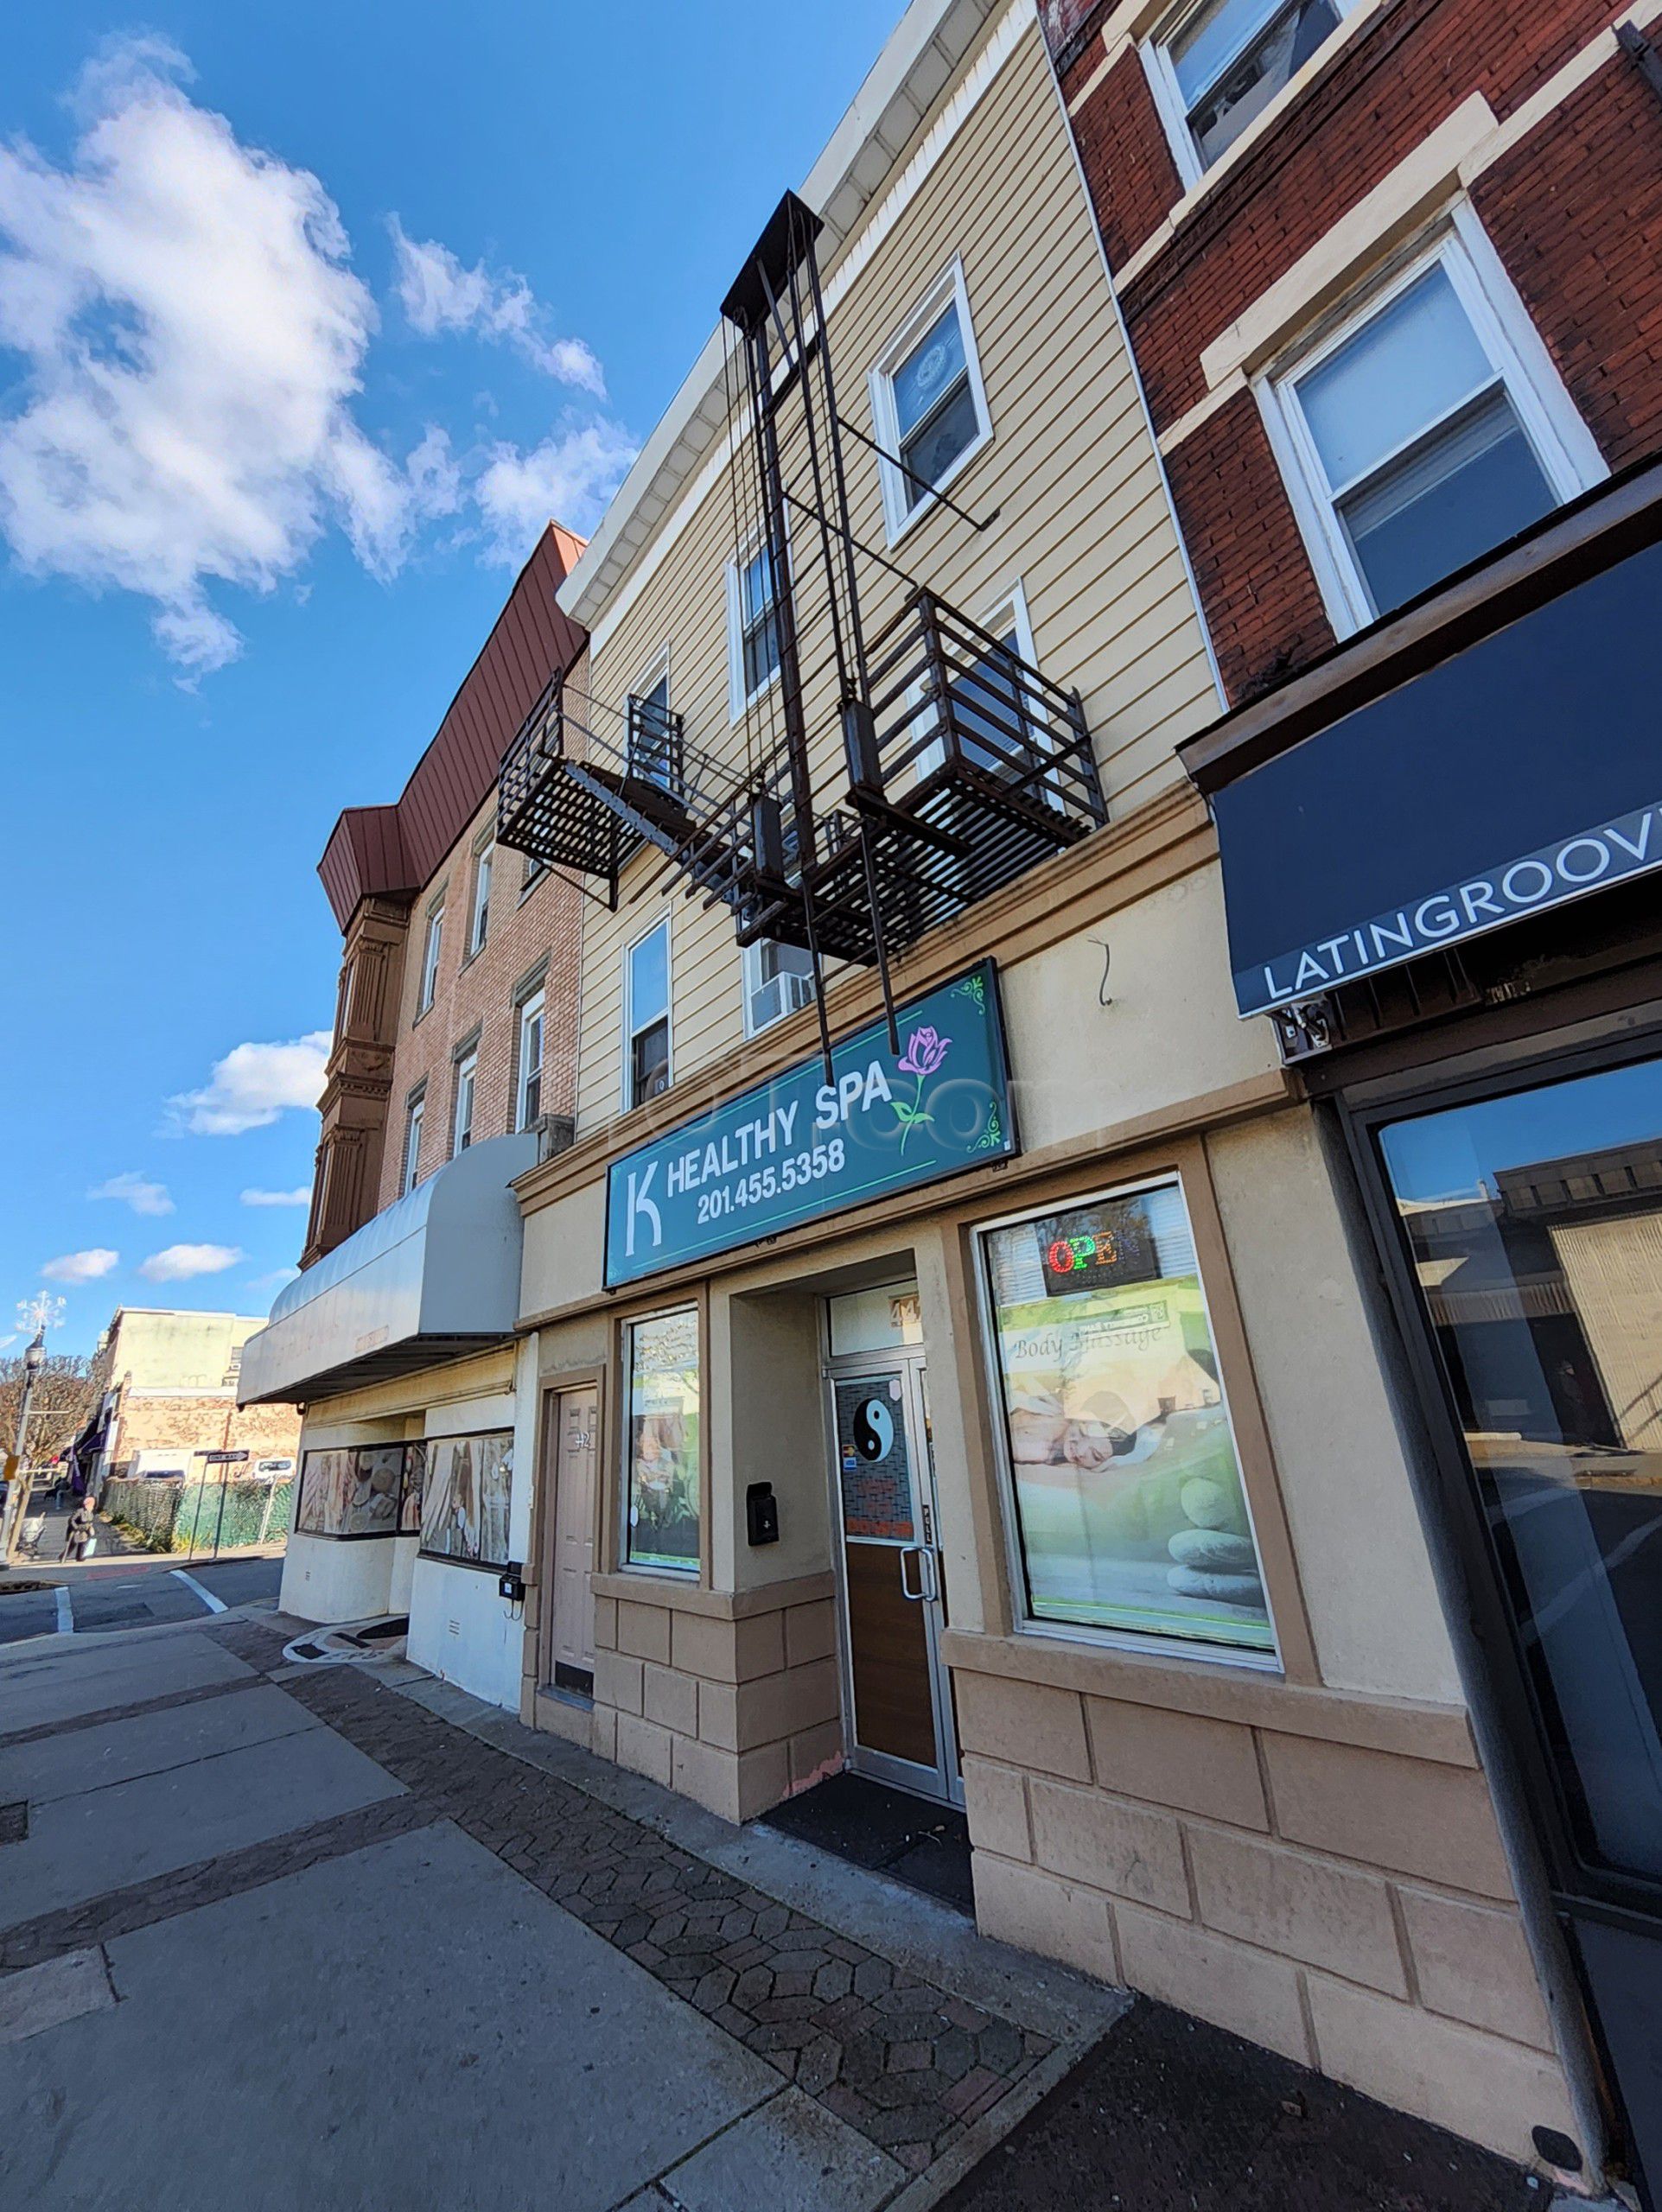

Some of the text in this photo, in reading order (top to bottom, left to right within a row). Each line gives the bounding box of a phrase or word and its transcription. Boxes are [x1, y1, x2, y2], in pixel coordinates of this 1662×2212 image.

[1263, 809, 1662, 1001] LATINGROOV
[626, 1060, 893, 1257] K HEALTHY SPA
[696, 1139, 845, 1225] 201.455.5358
[1016, 1332, 1064, 1363] Body
